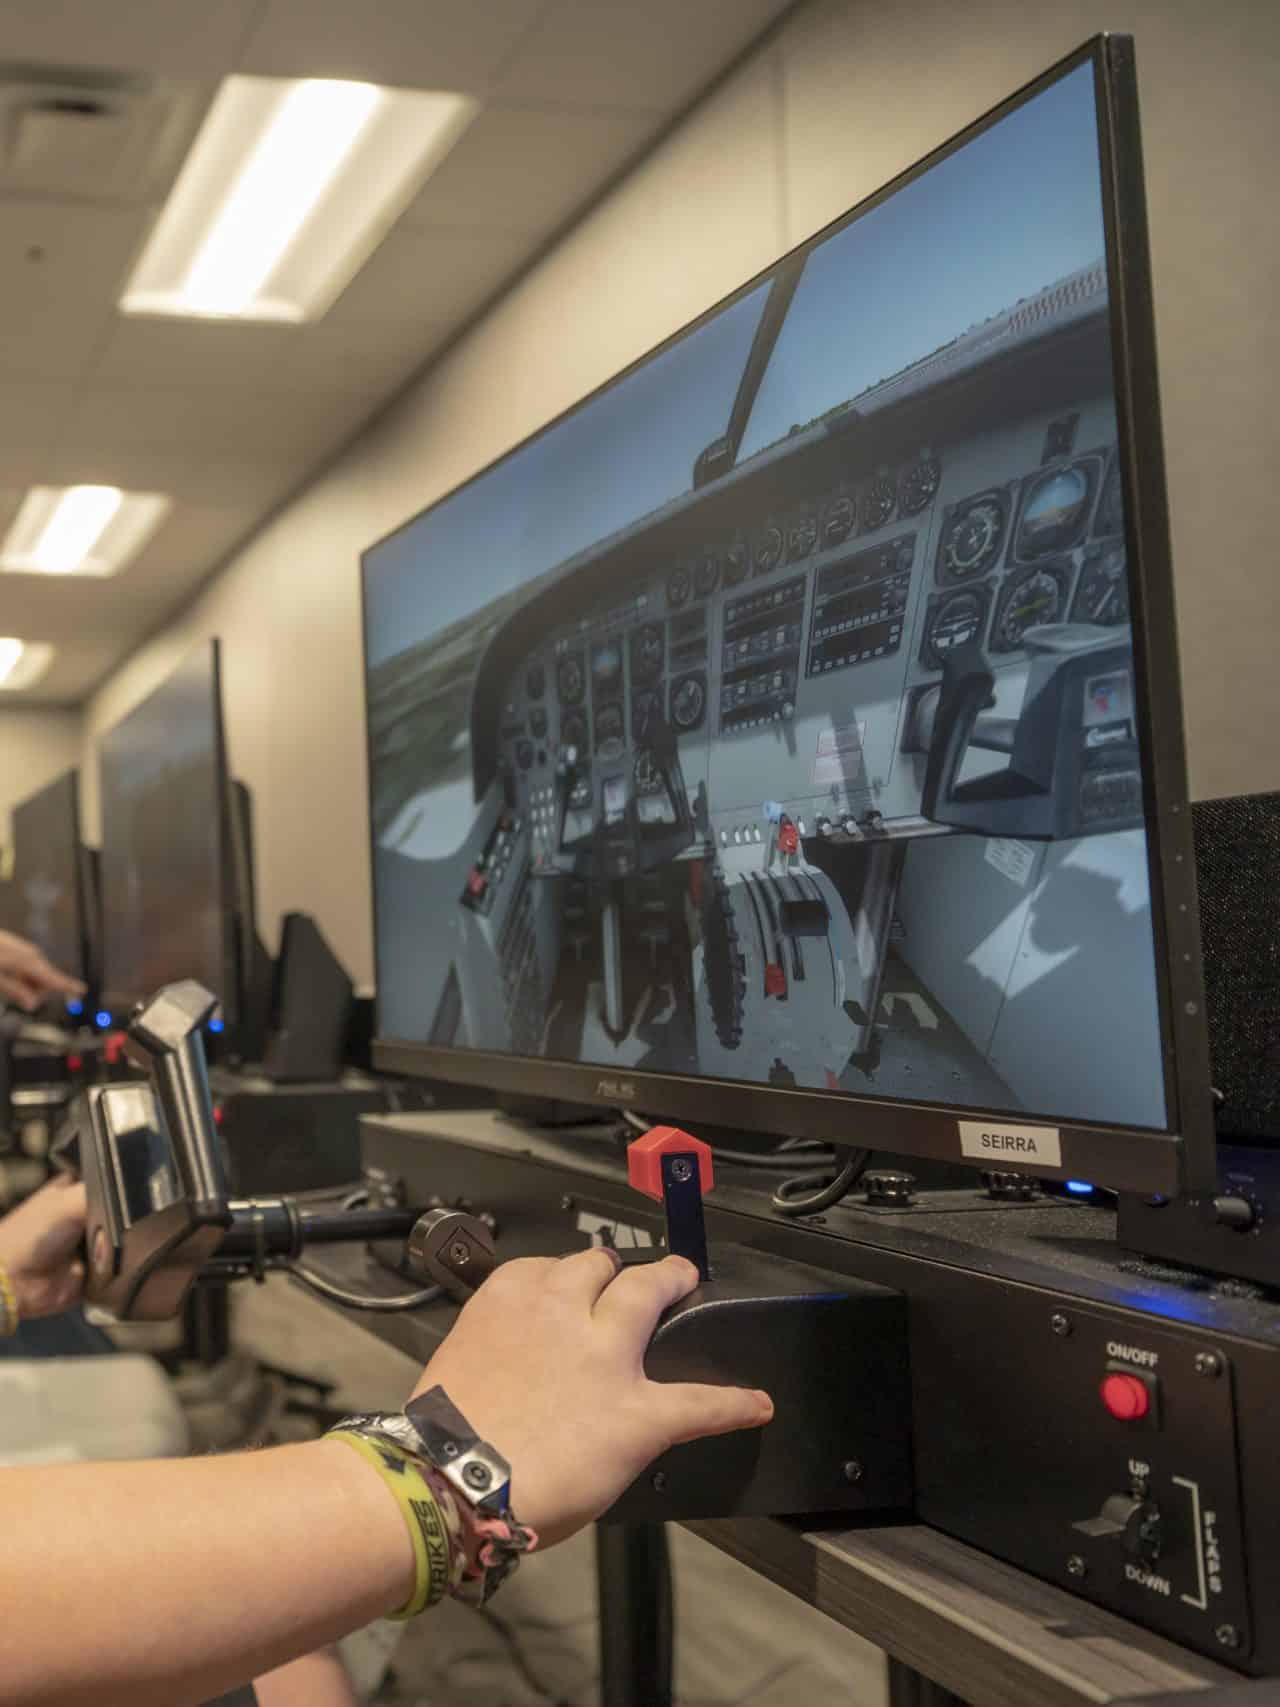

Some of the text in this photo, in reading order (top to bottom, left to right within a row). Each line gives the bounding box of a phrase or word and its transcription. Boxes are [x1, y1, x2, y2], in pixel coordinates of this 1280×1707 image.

[981, 1133, 1038, 1153] SEIRRA
[1107, 1341, 1158, 1367] ON/OFF
[1128, 1458, 1150, 1476] UP
[1125, 1564, 1170, 1595] DOWN
